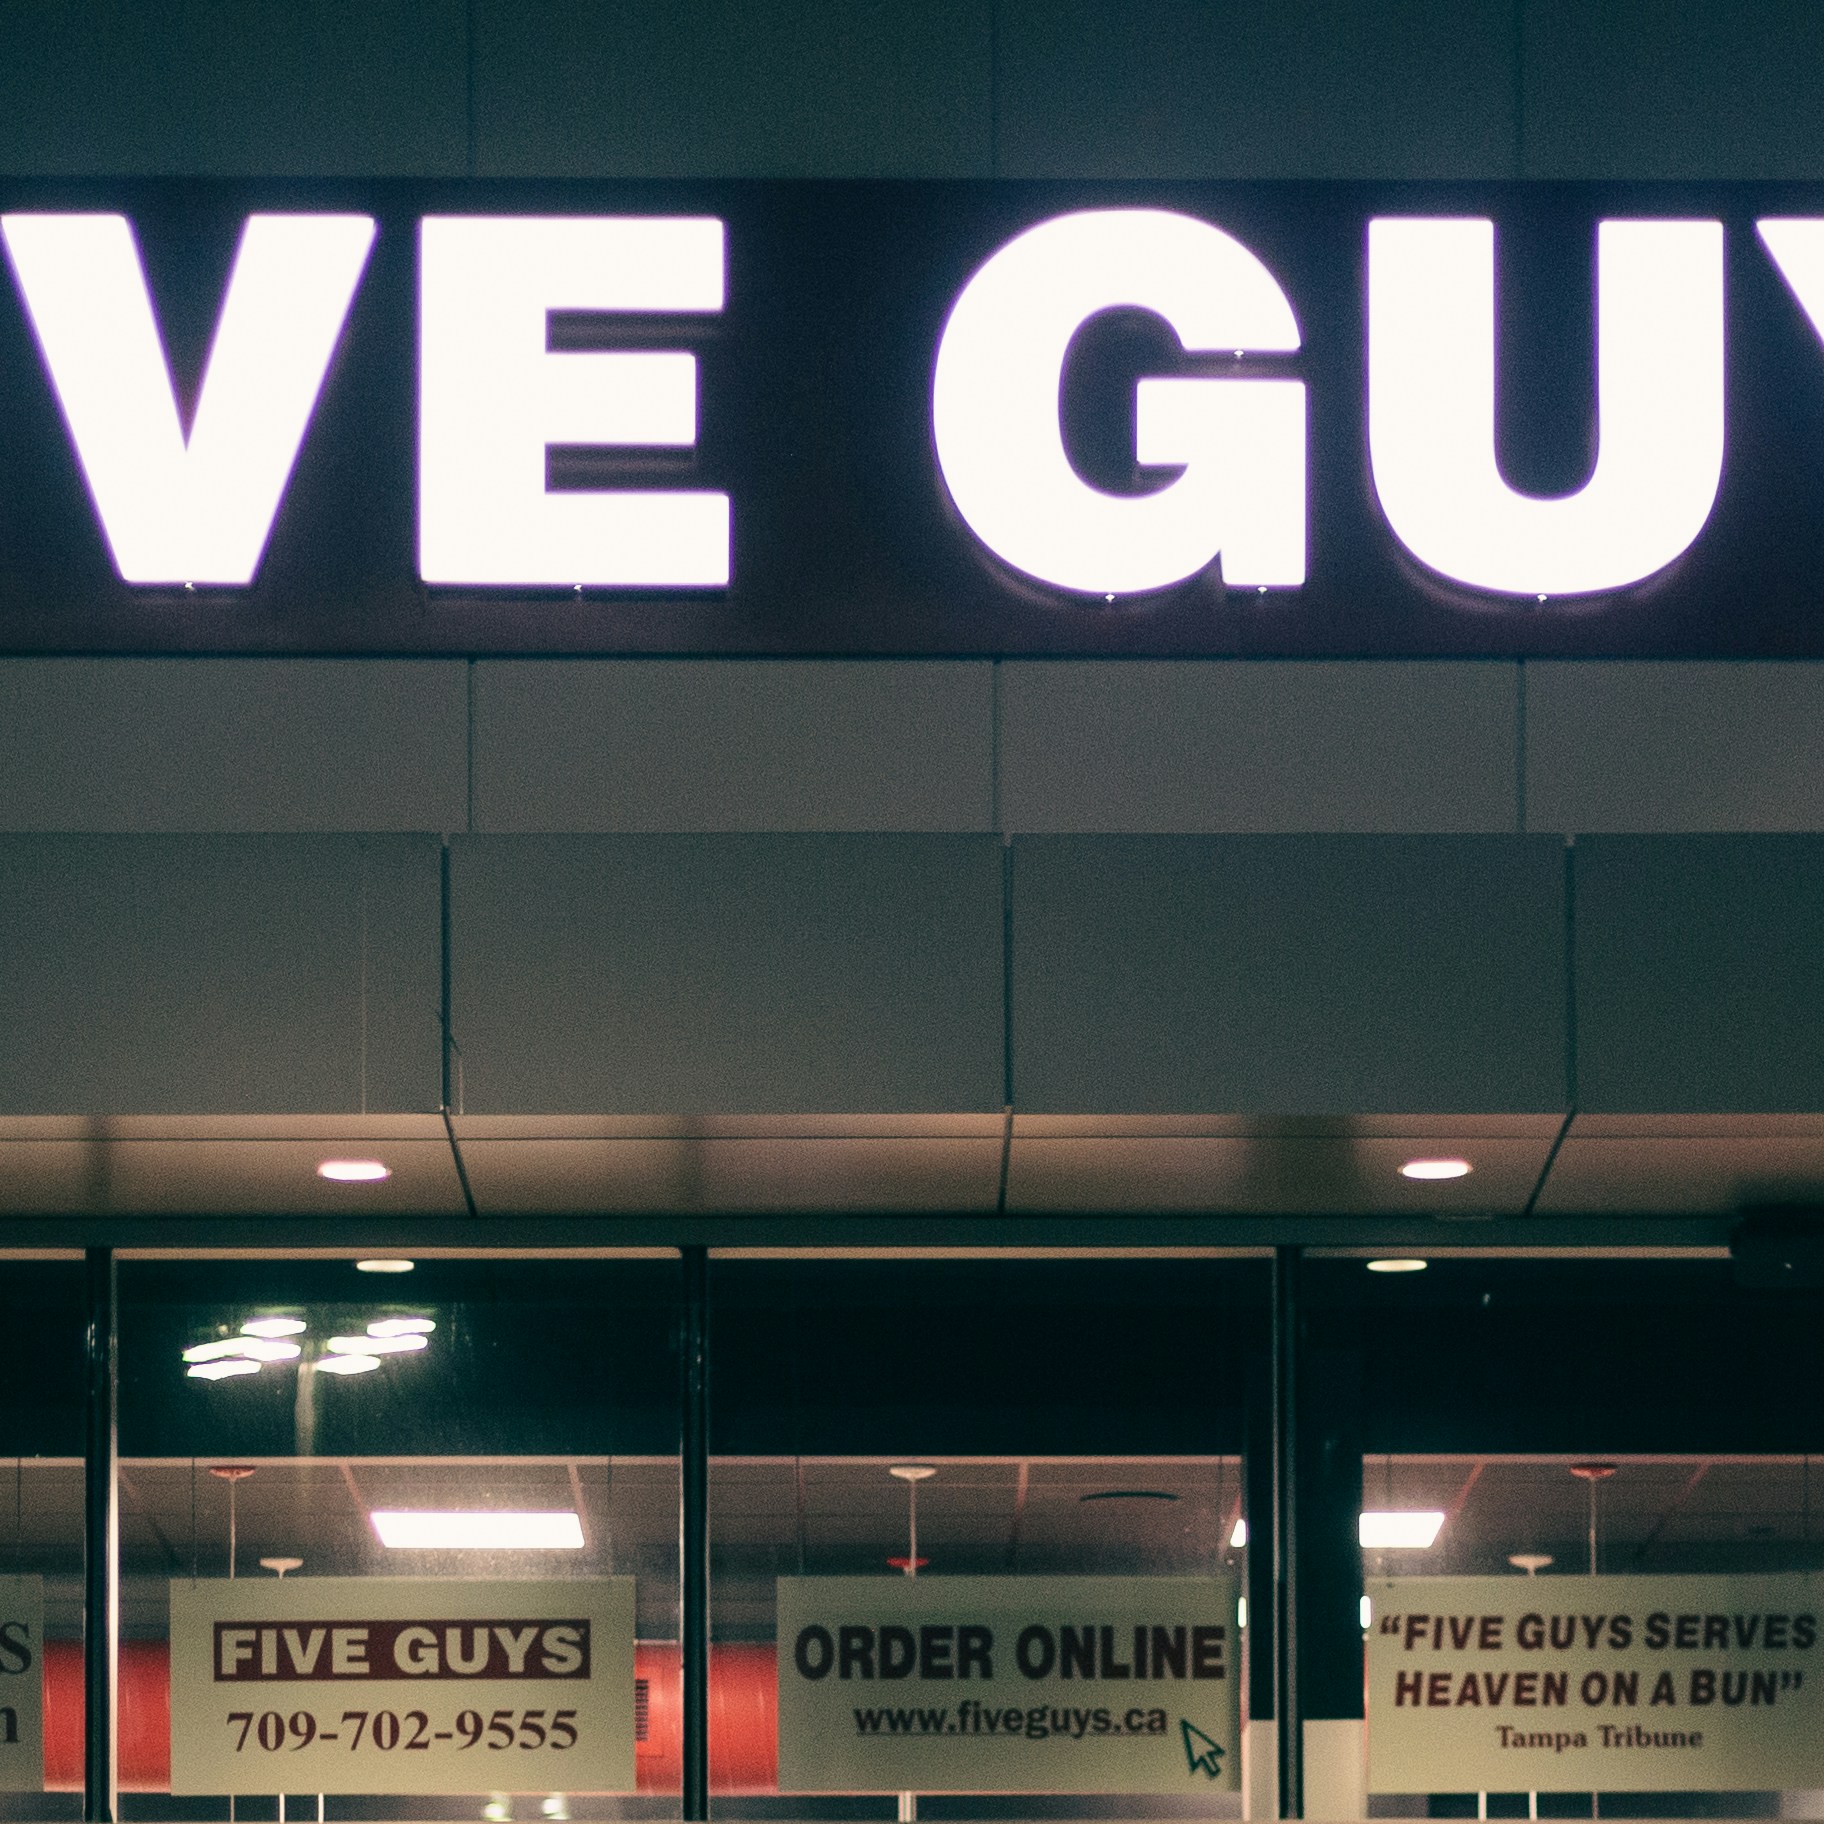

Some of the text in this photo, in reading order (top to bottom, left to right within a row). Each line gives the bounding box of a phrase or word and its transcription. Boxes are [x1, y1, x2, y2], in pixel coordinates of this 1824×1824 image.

[1516, 1613, 1632, 1650] GUYS
[1643, 1611, 1818, 1650] SERVES
[220, 1626, 584, 1676] FIVE GUYS
[793, 1624, 1227, 1681] ORDER ONLINE
[1394, 1671, 1570, 1707] HEAVEN
[1580, 1671, 1639, 1706] ON
[1649, 1671, 1677, 1706] A
[225, 1709, 579, 1752] 709-702-9555
[853, 1700, 1168, 1739] www.fiveguys.ca
[1496, 1725, 1705, 1753] Tampa Tribune
